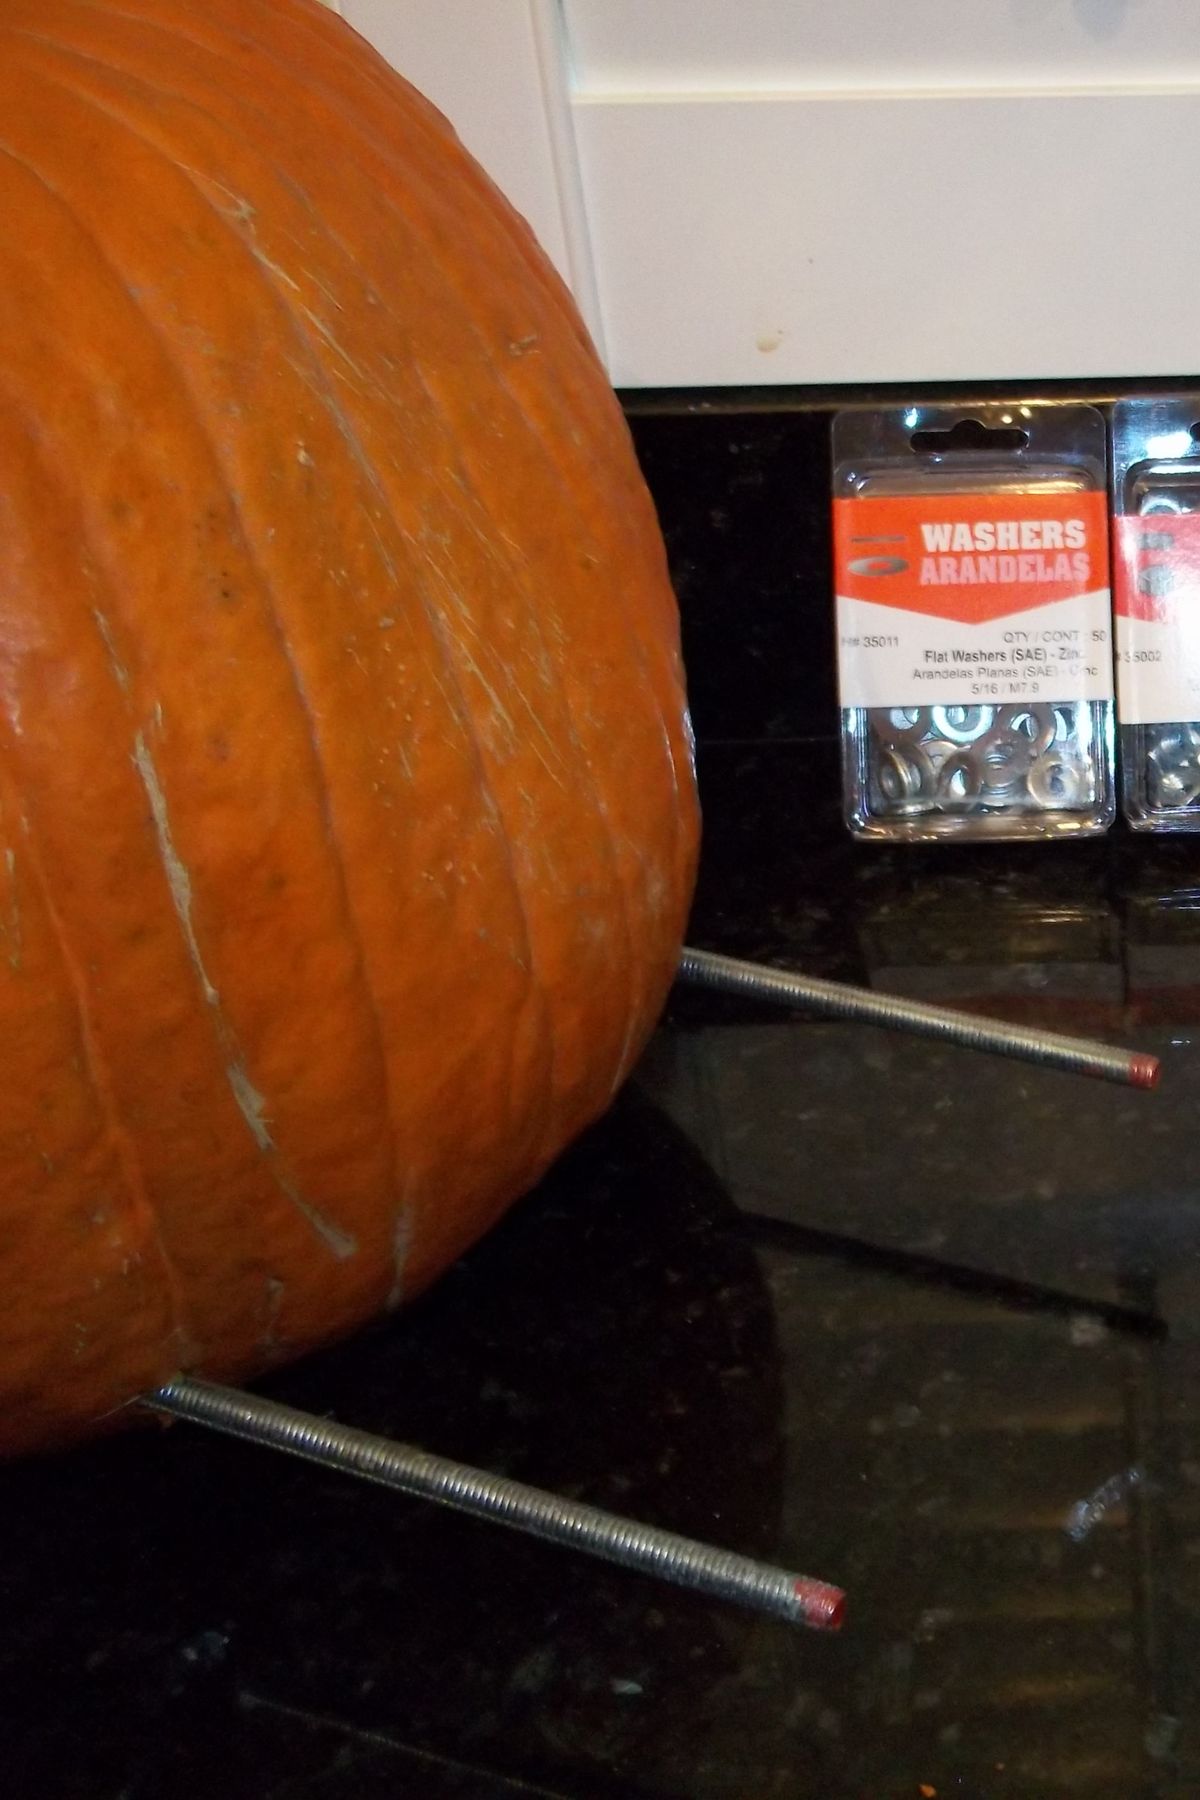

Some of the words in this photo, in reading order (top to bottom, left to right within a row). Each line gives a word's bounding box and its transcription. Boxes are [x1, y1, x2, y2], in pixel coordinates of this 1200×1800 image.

[921, 520, 1087, 553] WASHERS
[919, 552, 1090, 586] ARANDELAS
[863, 635, 899, 648] 35011
[1003, 631, 1031, 643] QTY
[1042, 630, 1079, 643] CONT
[925, 650, 949, 664] Flat
[951, 649, 1008, 663] Washers
[1011, 647, 1047, 664] (SAE)
[912, 668, 974, 680] Arandelas
[977, 667, 1019, 679] Planas
[1069, 664, 1099, 677] Cnc
[971, 682, 998, 696] 5/16
